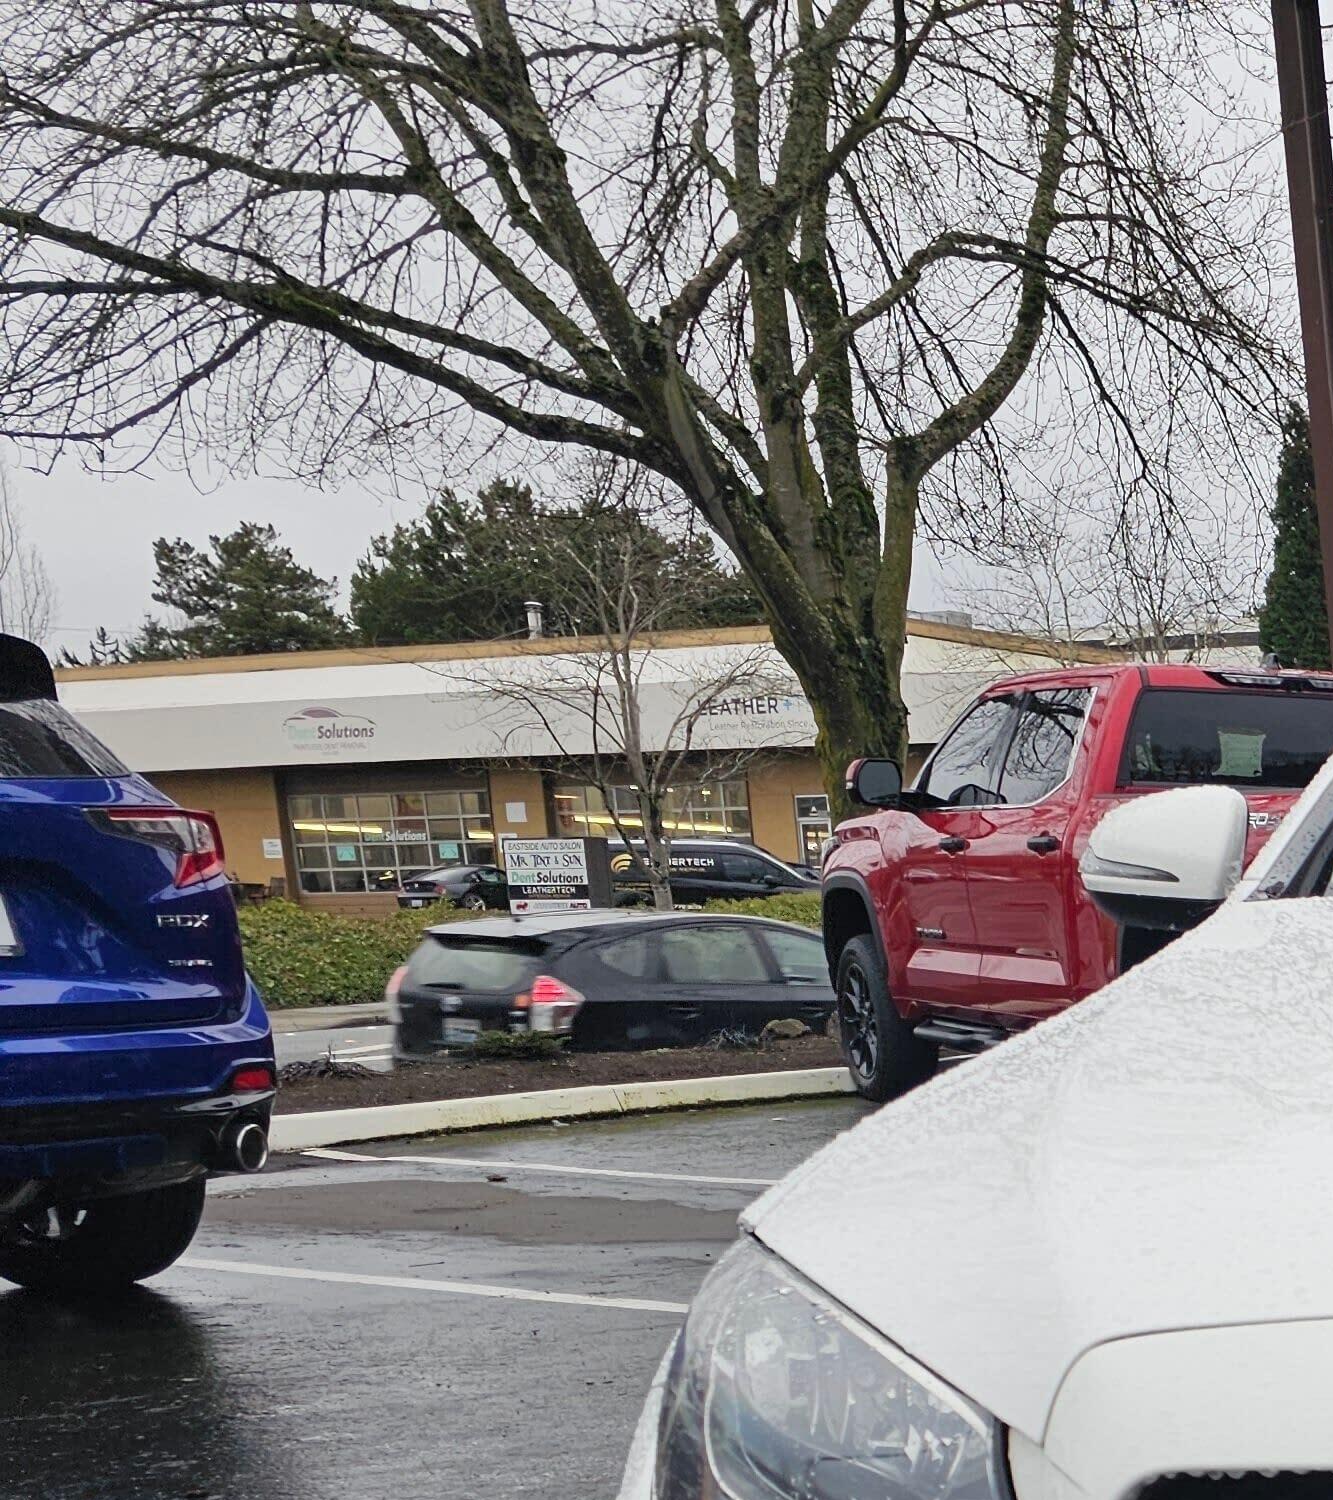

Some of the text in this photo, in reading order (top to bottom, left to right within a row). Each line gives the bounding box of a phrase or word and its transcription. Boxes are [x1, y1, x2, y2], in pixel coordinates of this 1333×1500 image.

[697, 697, 779, 715] LEATHER
[540, 842, 558, 850] AUTO
[560, 841, 581, 849] SALON
